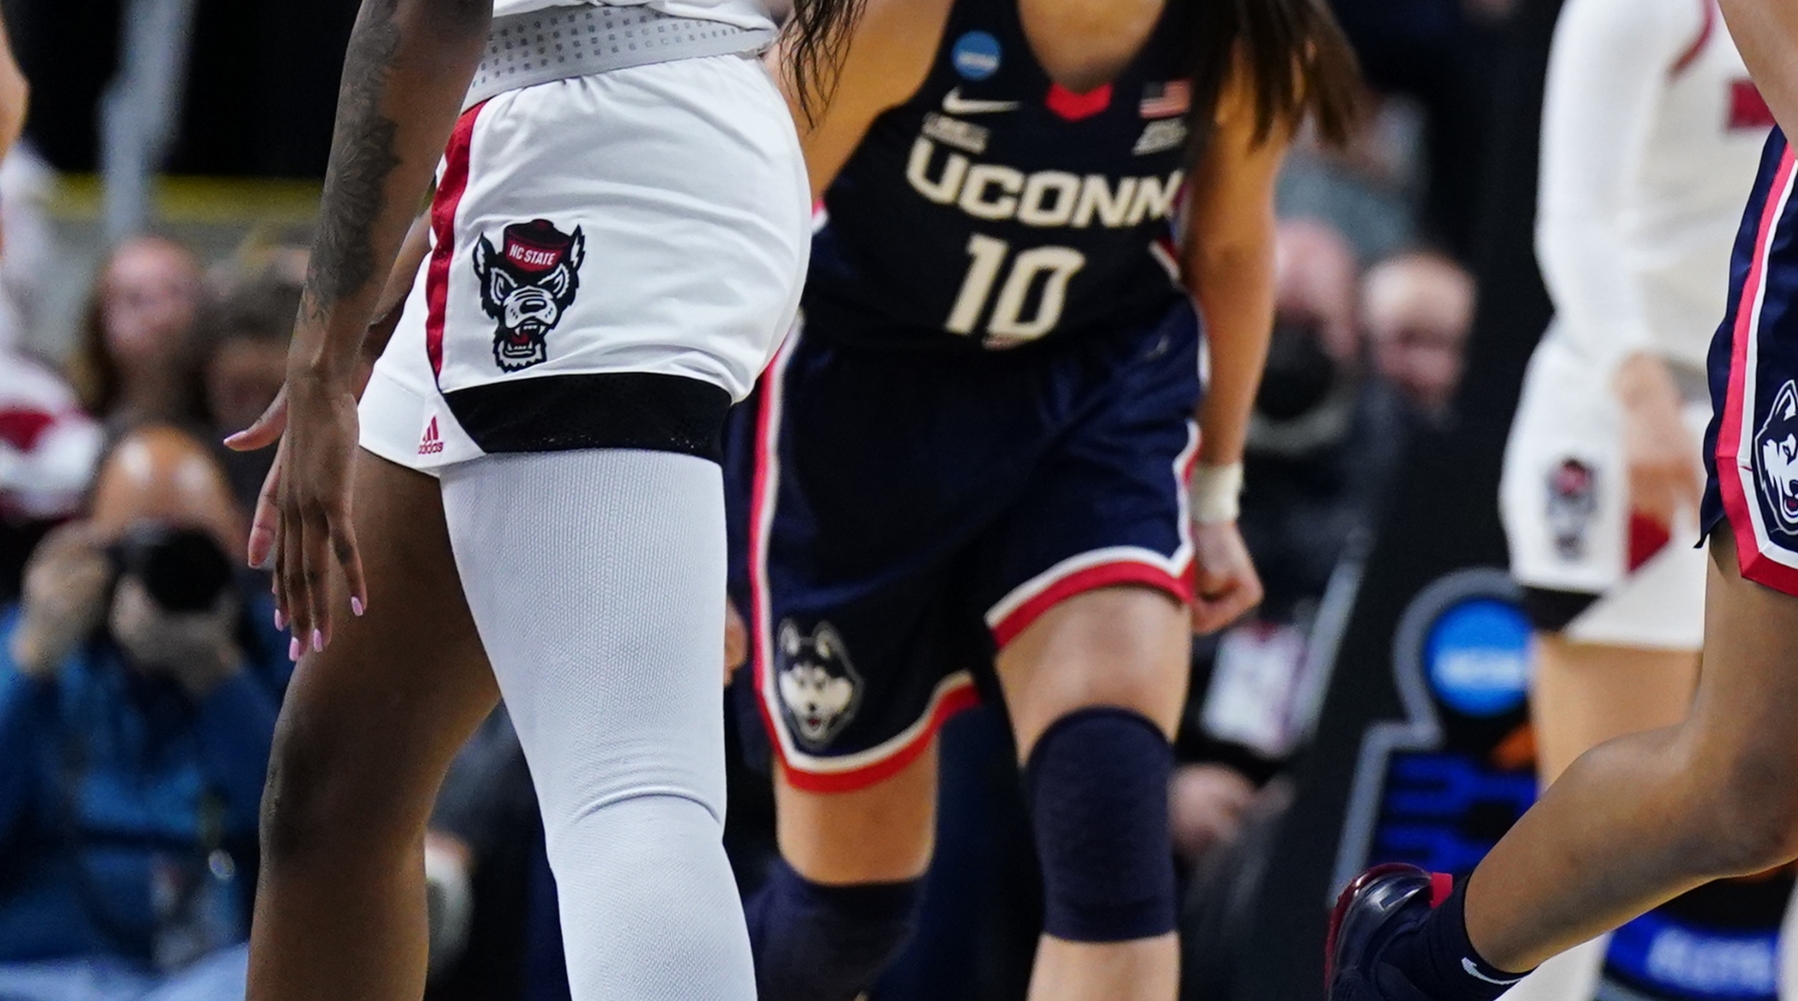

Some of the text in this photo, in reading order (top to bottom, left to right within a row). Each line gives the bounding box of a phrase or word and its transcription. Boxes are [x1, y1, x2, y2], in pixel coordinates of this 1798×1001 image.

[906, 134, 1184, 228] UCONN
[509, 244, 556, 266] NC STATE
[945, 231, 1086, 340] 10
